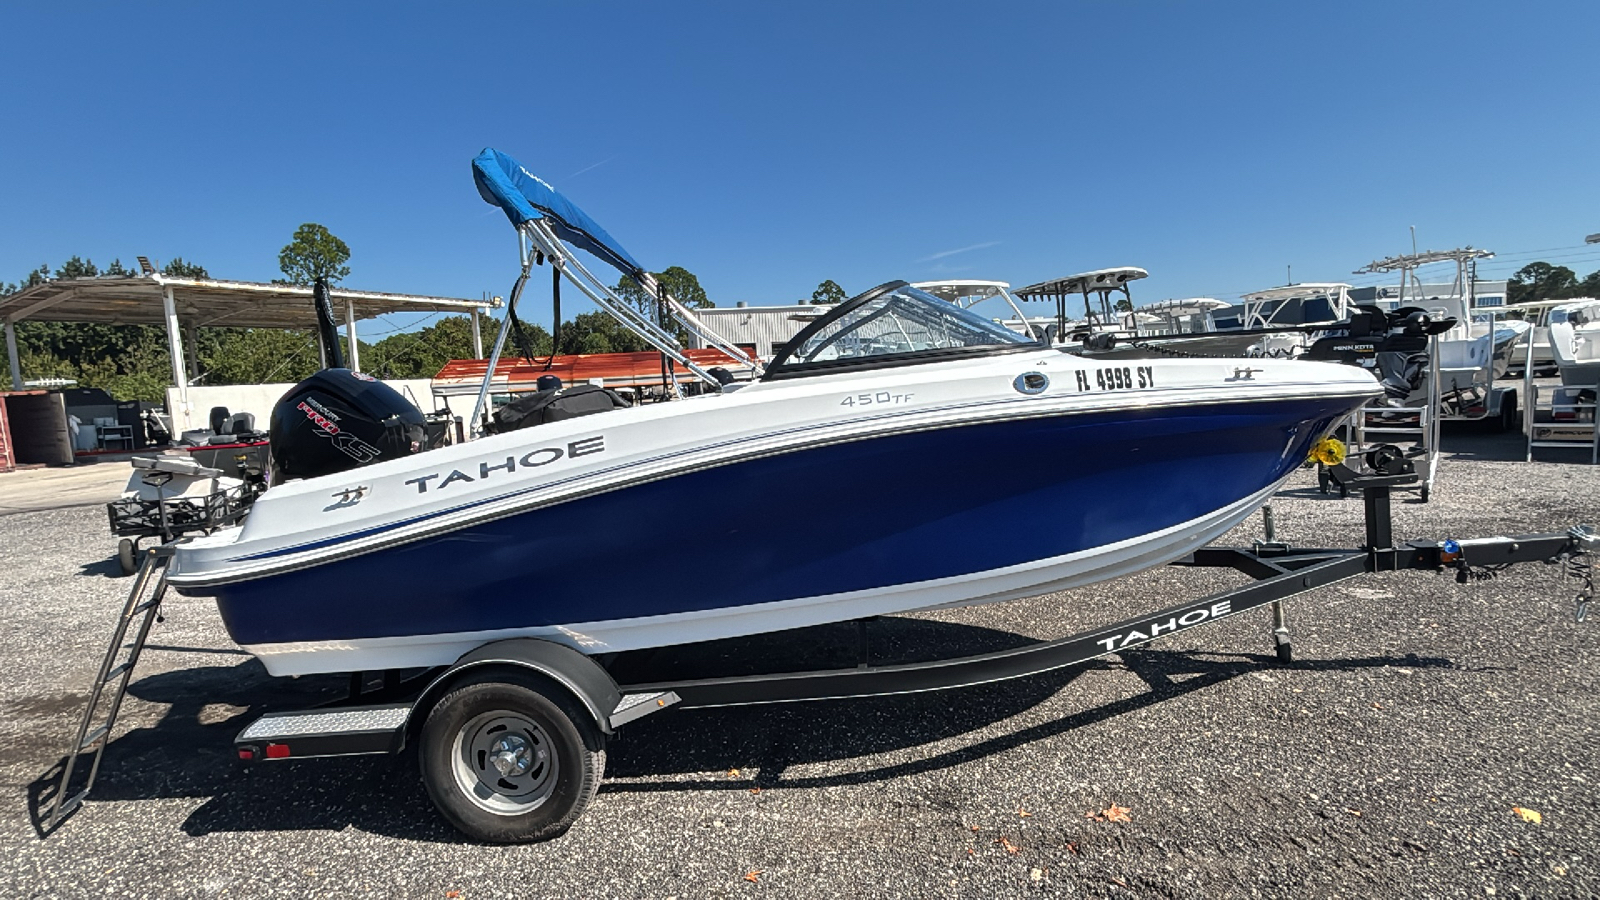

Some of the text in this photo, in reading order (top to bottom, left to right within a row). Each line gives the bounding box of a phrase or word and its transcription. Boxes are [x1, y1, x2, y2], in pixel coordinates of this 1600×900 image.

[1075, 366, 1154, 392] FL 4998 SY
[297, 401, 340, 435] PRO
[306, 396, 342, 422] MERCURY
[312, 428, 382, 463] XS
[404, 435, 605, 494] TAHOE
[1096, 600, 1231, 651] TAHOE
